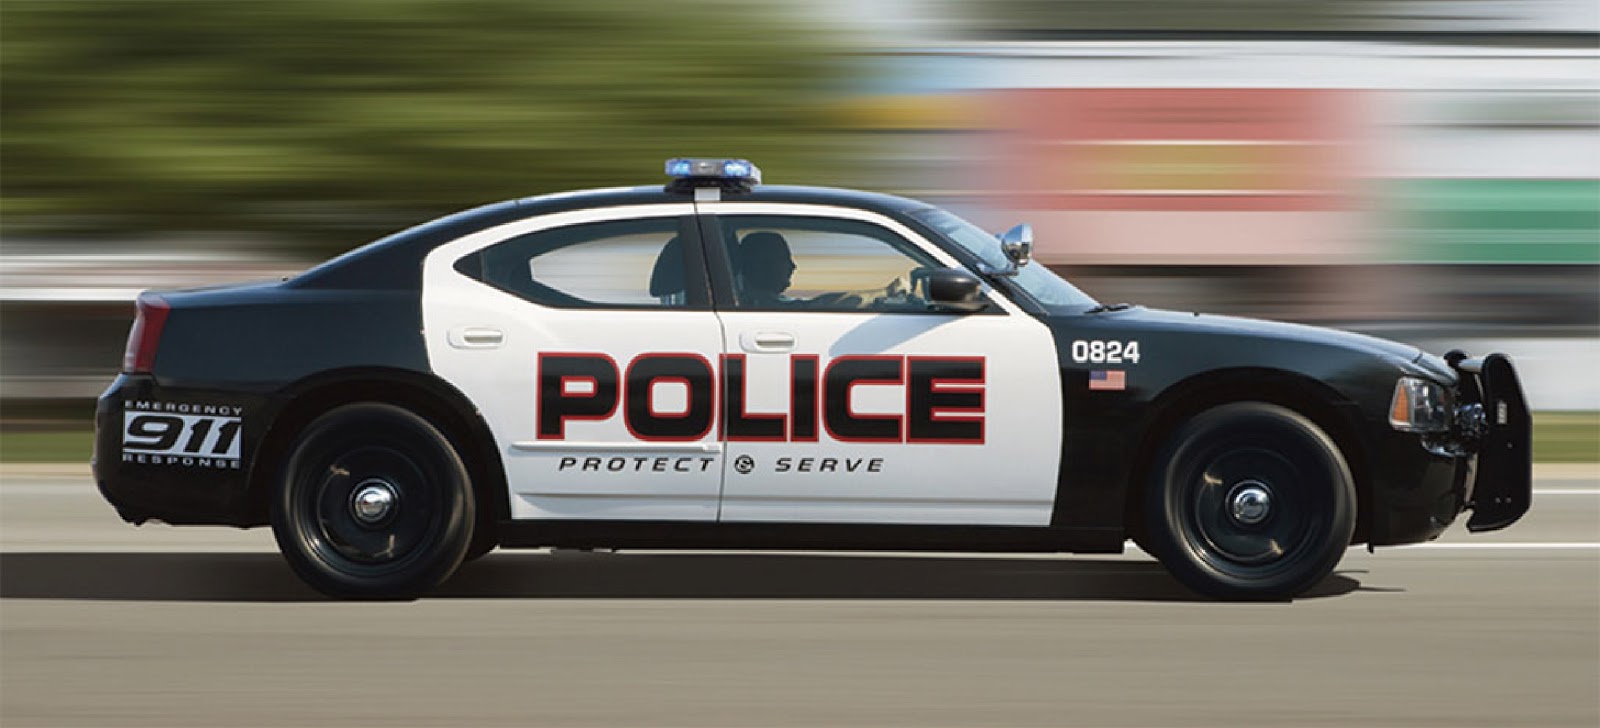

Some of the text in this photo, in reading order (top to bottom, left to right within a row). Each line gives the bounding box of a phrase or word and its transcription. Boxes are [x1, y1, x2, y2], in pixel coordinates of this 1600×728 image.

[1072, 340, 1140, 364] 0824
[124, 400, 242, 415] EMERGENCY
[536, 351, 986, 444] POLICE
[123, 415, 241, 454] 911
[122, 453, 240, 469] RESPONSE
[558, 456, 716, 472] PROTECT
[774, 457, 884, 472] SERVE
